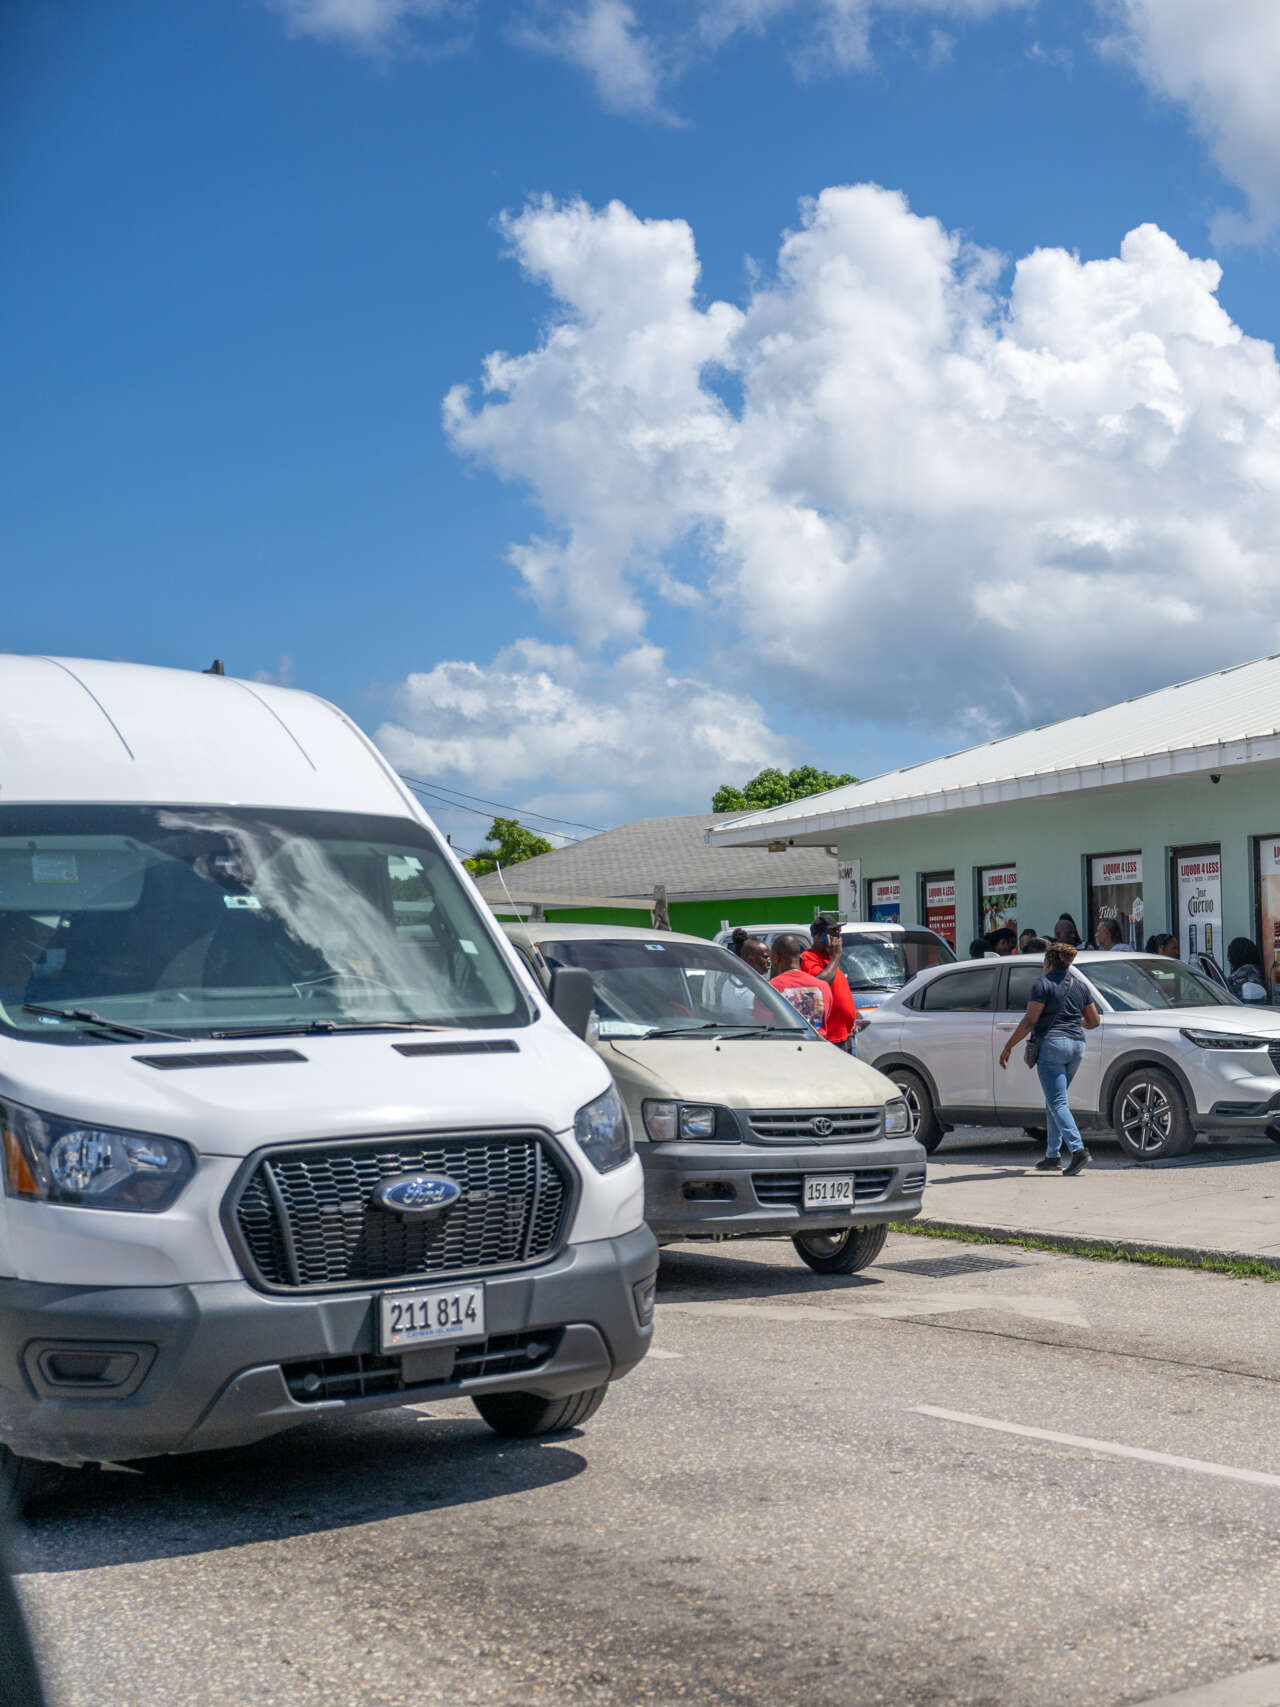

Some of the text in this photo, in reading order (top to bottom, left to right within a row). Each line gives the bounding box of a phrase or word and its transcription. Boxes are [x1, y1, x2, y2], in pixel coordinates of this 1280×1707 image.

[1103, 863, 1121, 876] LIQUOR
[1125, 861, 1137, 873] LESS
[1181, 861, 1219, 877] LIQUOR 4 LESS
[1187, 895, 1214, 917] Cuervo
[402, 1183, 445, 1203] Ford
[808, 1182, 850, 1201] 151 192
[390, 1294, 477, 1333] 211 814
